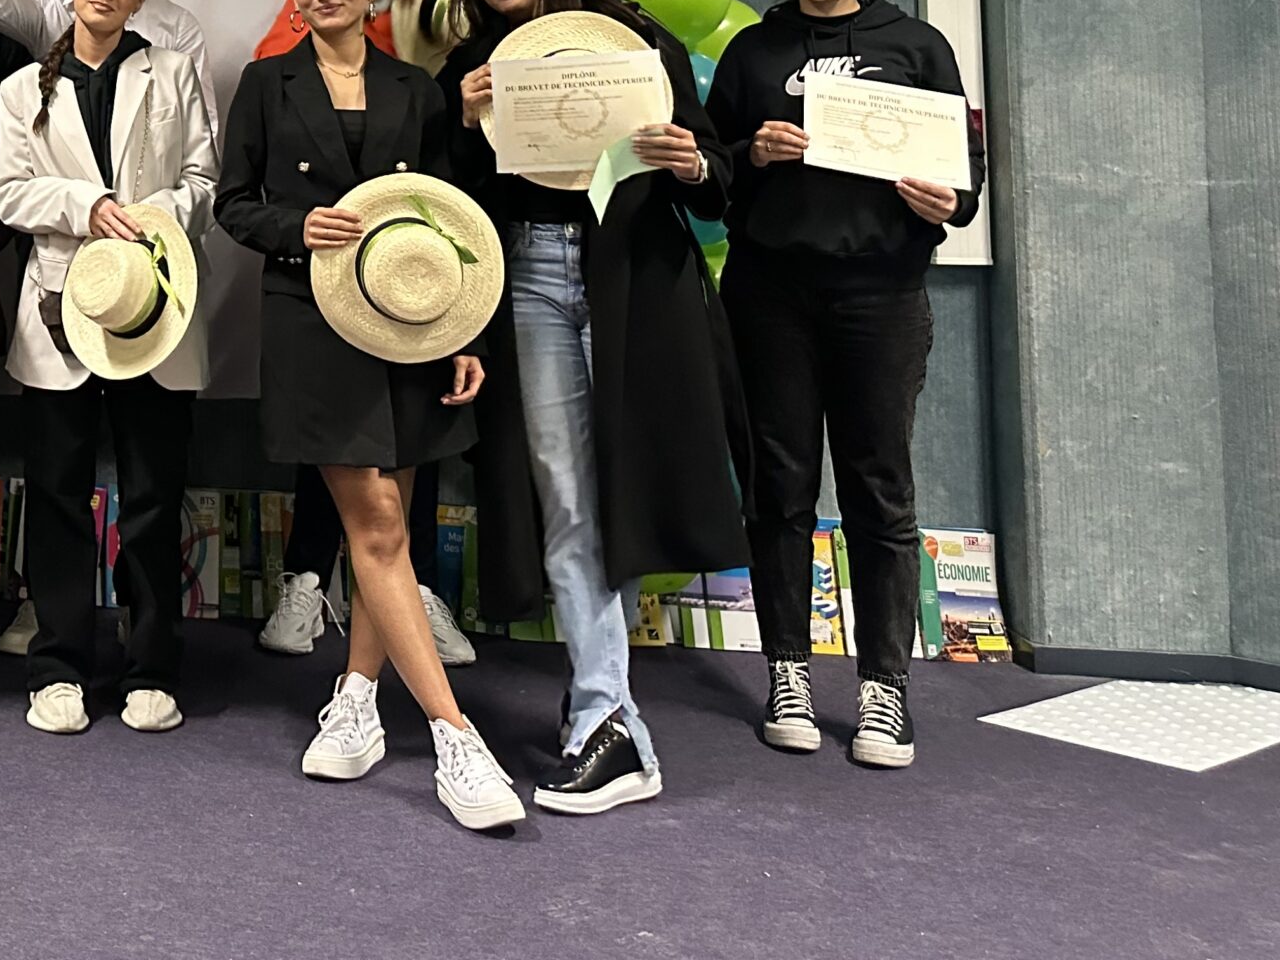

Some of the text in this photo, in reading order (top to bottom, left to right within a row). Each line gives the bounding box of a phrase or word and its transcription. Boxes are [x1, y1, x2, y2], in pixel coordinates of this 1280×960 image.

[561, 70, 598, 80] DIPLÔME
[518, 83, 549, 92] BREVET
[551, 82, 562, 90] DE
[564, 79, 611, 89] TECHNICIEN
[937, 560, 991, 583] ÉCONOMIE
